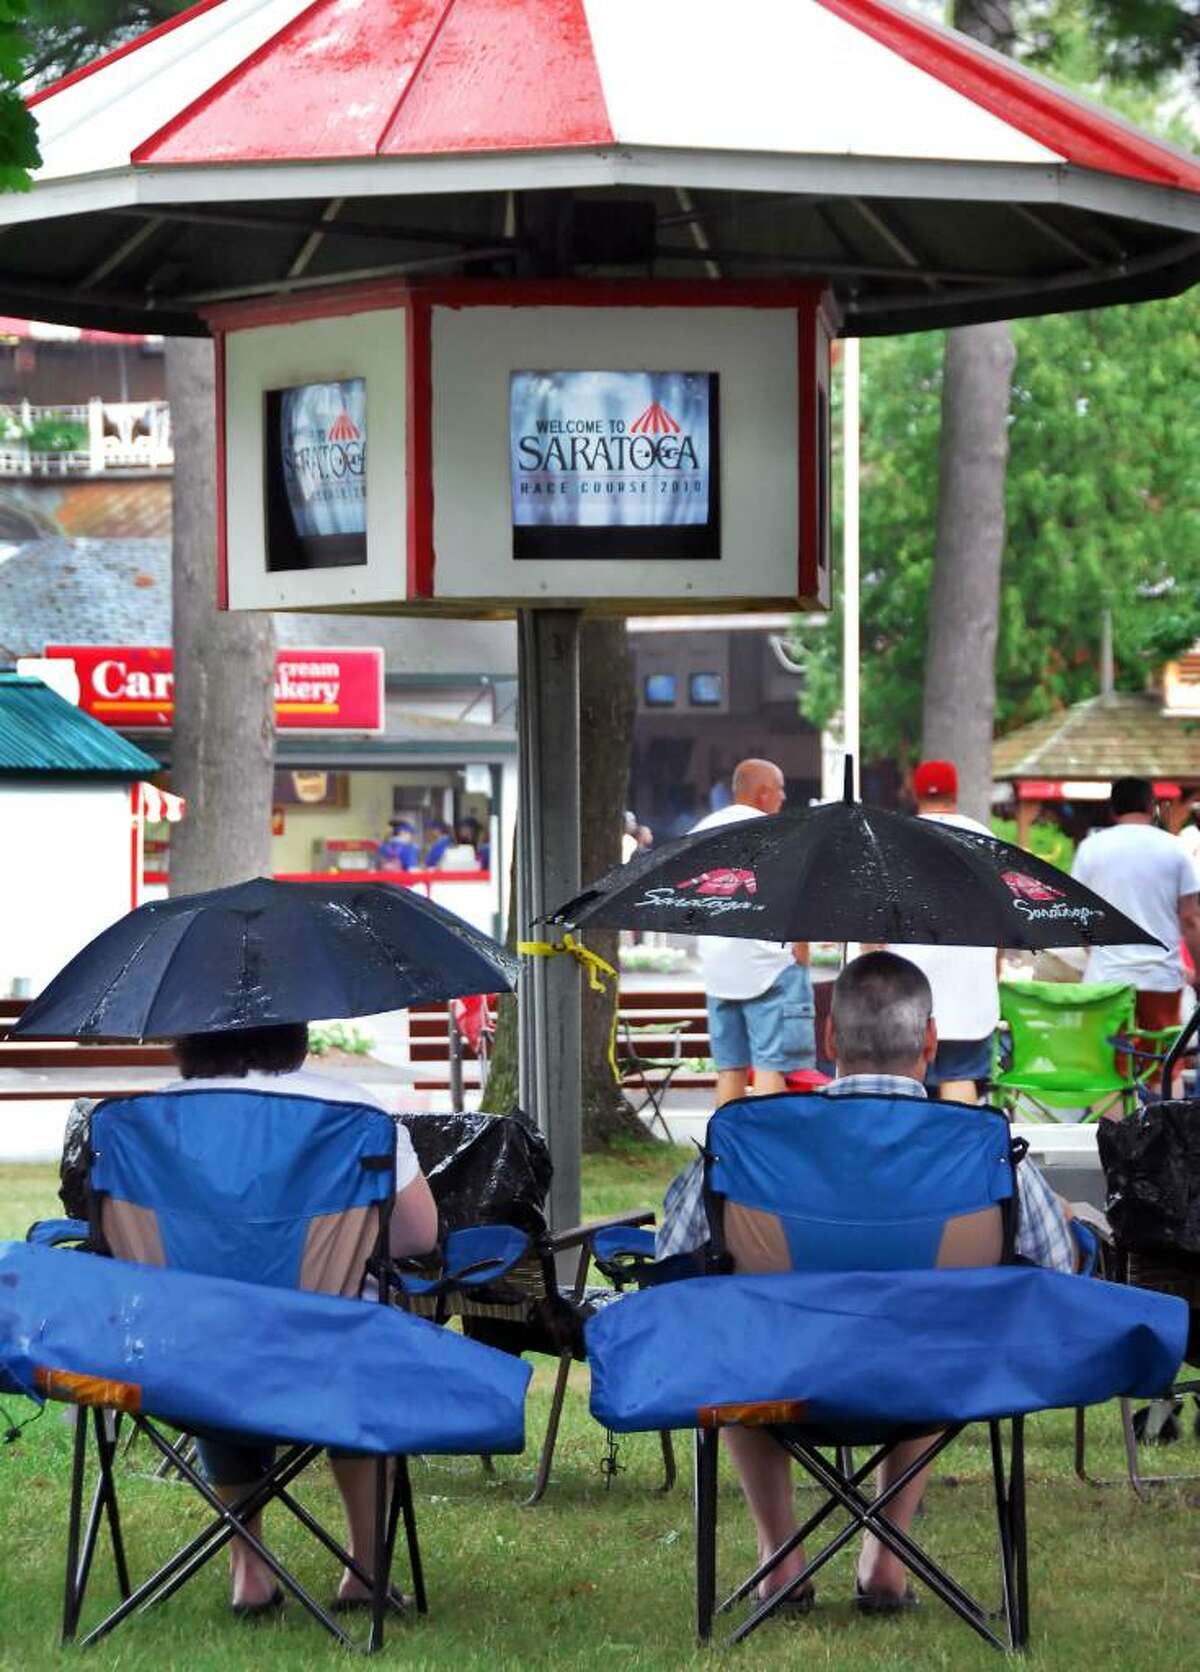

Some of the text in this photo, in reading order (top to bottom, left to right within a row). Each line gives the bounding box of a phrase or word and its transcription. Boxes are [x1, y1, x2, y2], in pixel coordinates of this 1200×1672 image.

[536, 420, 626, 434] WELCOME TO
[518, 435, 700, 471] SARATOGA
[520, 481, 702, 494] RACE COURSE 2010
[278, 662, 340, 677] cream
[91, 660, 174, 698] Car
